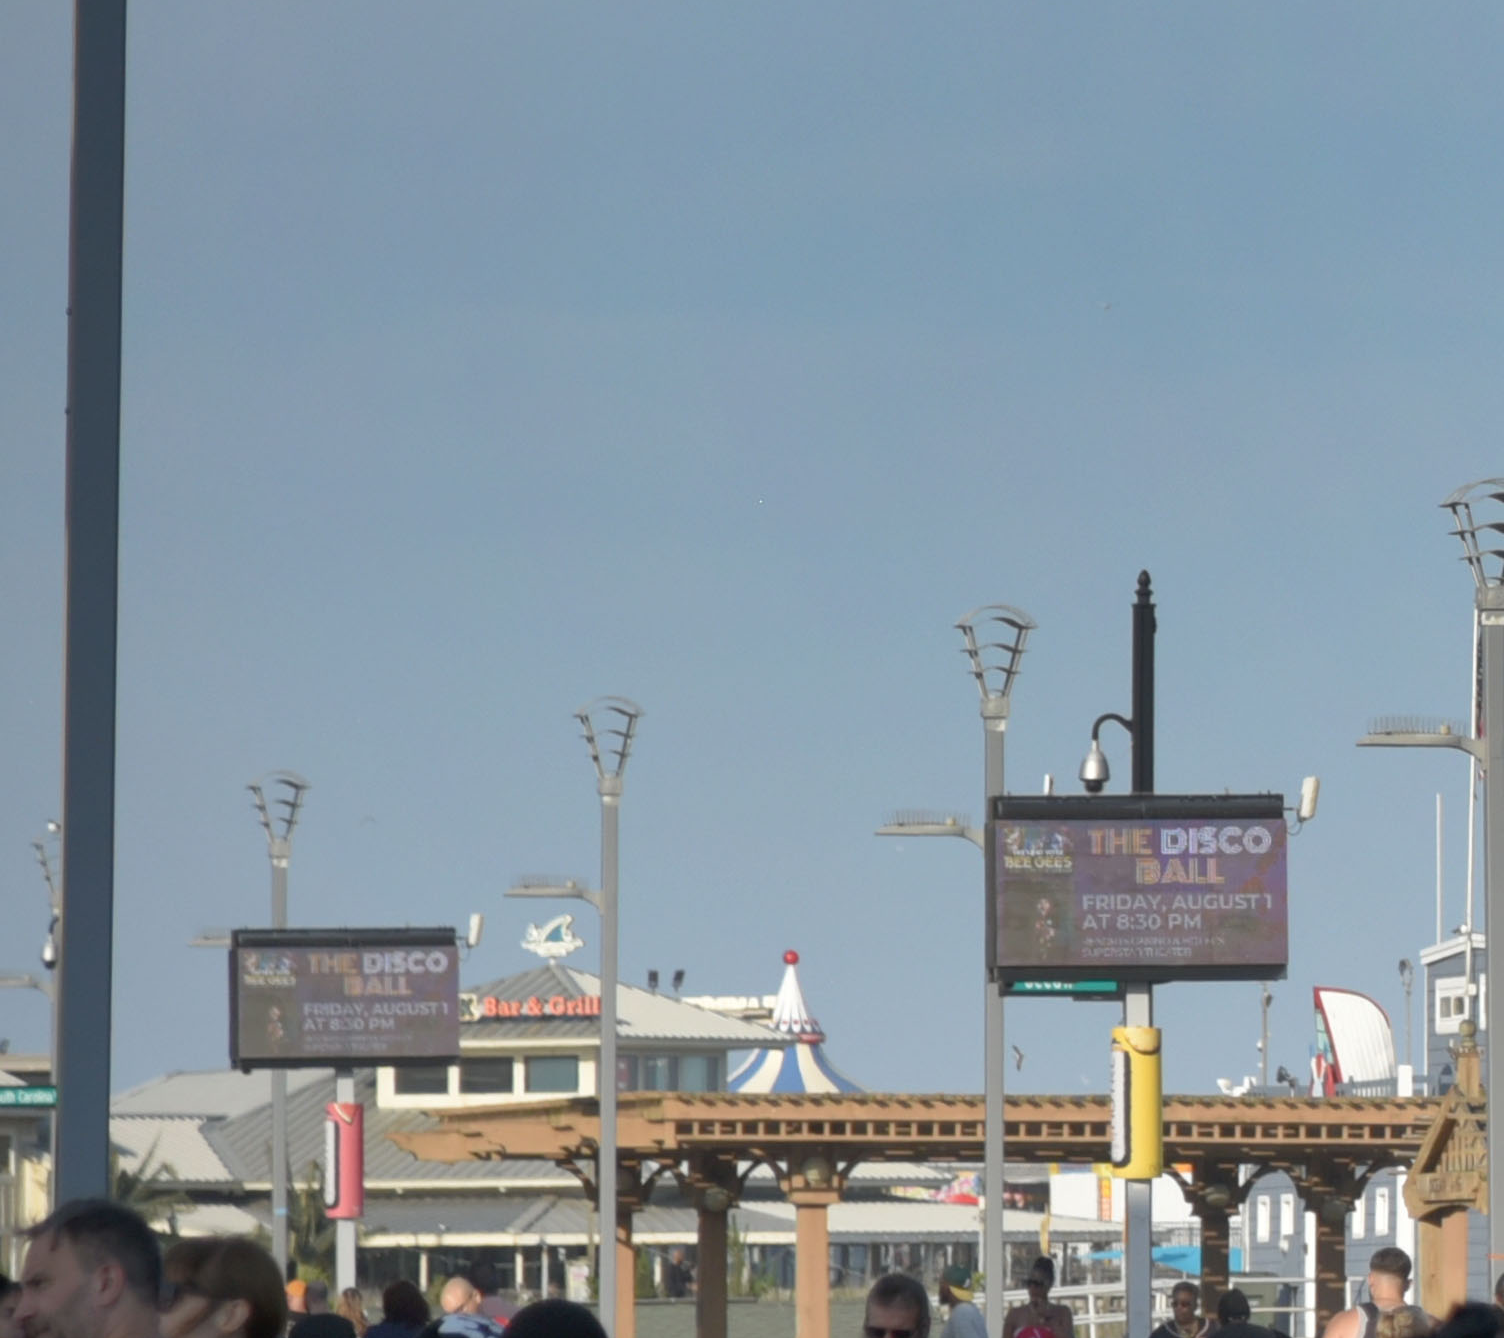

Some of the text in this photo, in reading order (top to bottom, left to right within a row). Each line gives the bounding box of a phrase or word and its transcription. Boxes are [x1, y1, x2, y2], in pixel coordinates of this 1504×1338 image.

[1087, 826, 1272, 855] THE DISCO
[1135, 857, 1225, 884] BALL
[1081, 892, 1273, 912] FRIDAY, AUGUST 1
[1081, 912, 1201, 930] AT 8:30 PM
[307, 950, 449, 974] THE DISCO
[344, 975, 413, 996] BALL
[303, 1002, 369, 1018] FRIDAY,
[371, 1001, 439, 1016] AUGUST
[484, 995, 521, 1017] Bar
[527, 995, 544, 1016] &
[549, 994, 602, 1016] Grill
[303, 1017, 325, 1031] AT
[368, 1017, 395, 1030] PM
